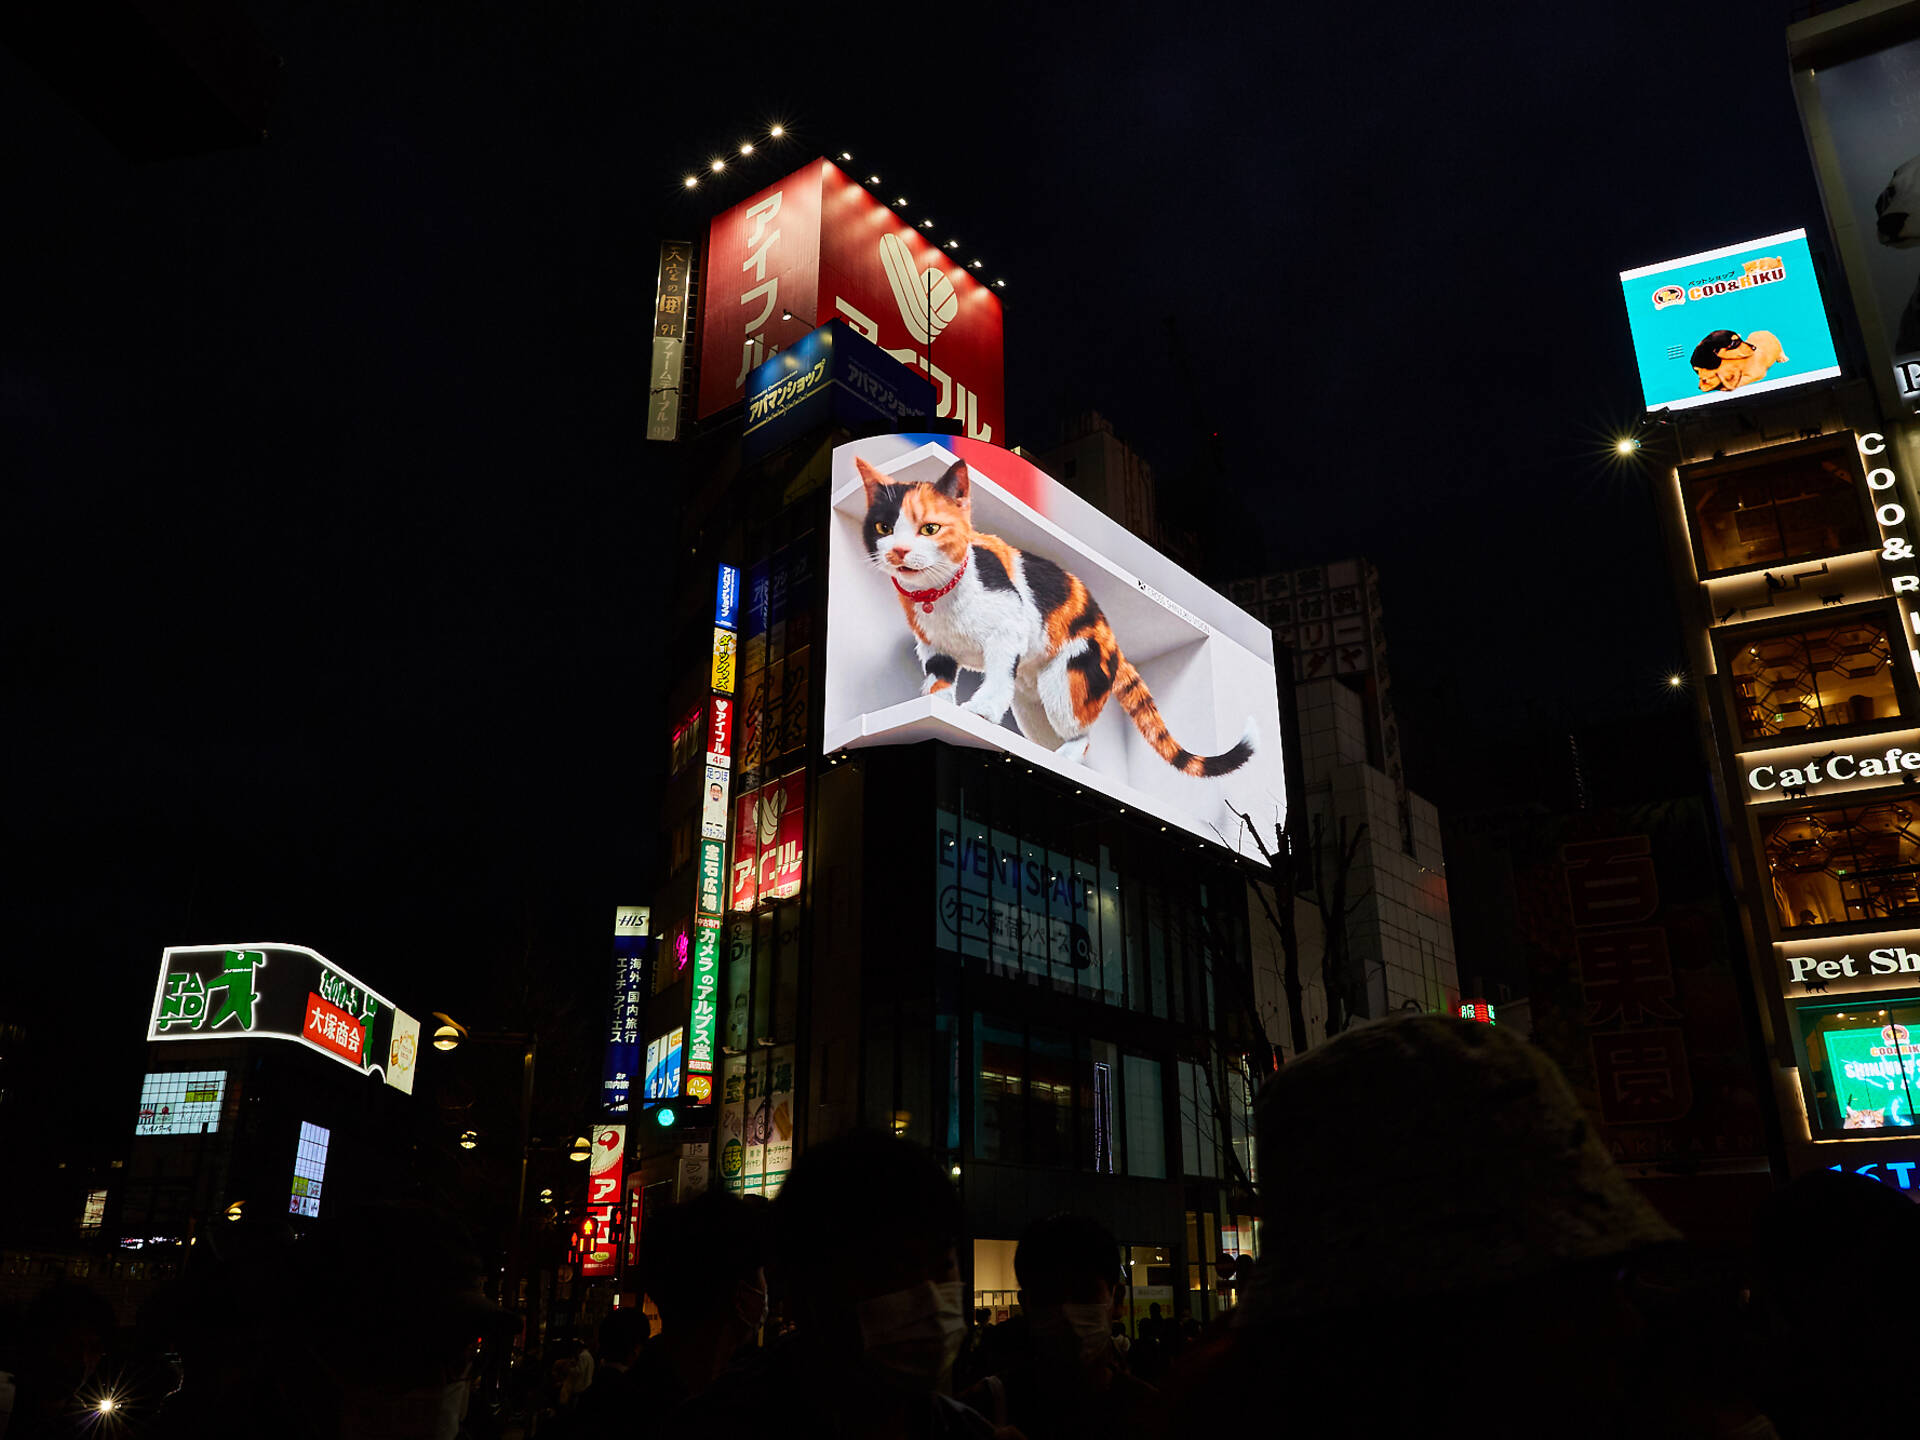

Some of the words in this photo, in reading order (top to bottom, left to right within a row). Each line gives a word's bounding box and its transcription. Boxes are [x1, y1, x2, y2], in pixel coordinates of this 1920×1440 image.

[736, 191, 783, 389] アイフル
[1689, 268, 1785, 300] COO&RIKU
[749, 358, 827, 423] アパマンショップ
[714, 711, 729, 754] アイフル
[713, 755, 725, 765] 4F
[1749, 761, 1823, 791] Cat
[1826, 748, 1920, 780] Cafe
[940, 829, 1022, 888] EVENT
[619, 915, 646, 926] HIS
[1786, 955, 1859, 983] Pet
[624, 958, 642, 1043] 海外・国内旅行
[692, 929, 717, 1060] カメラのアルプス堂
[309, 1007, 360, 1053] 大塚商会
